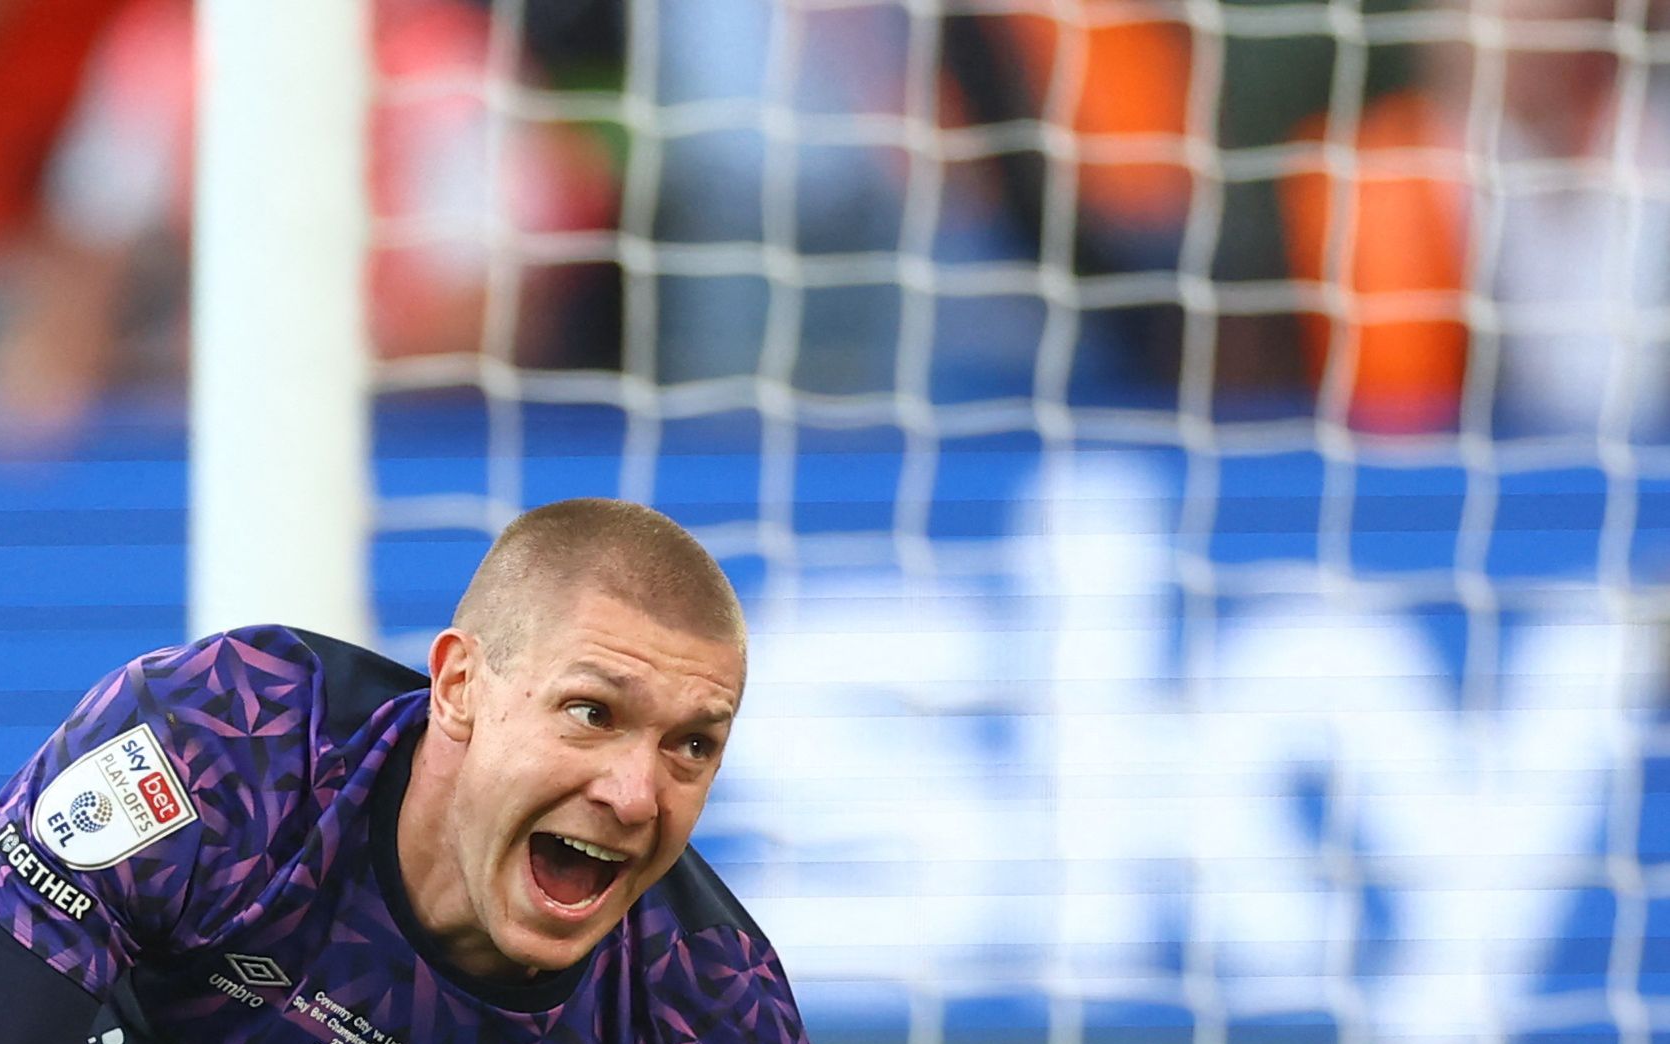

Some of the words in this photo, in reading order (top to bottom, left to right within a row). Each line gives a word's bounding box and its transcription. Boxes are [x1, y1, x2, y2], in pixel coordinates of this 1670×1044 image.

[99, 753, 154, 833] PLAY-OFFS
[121, 739, 150, 774] sky
[143, 773, 175, 820] bet
[47, 811, 75, 848] EFL
[209, 973, 264, 1008] umbro
